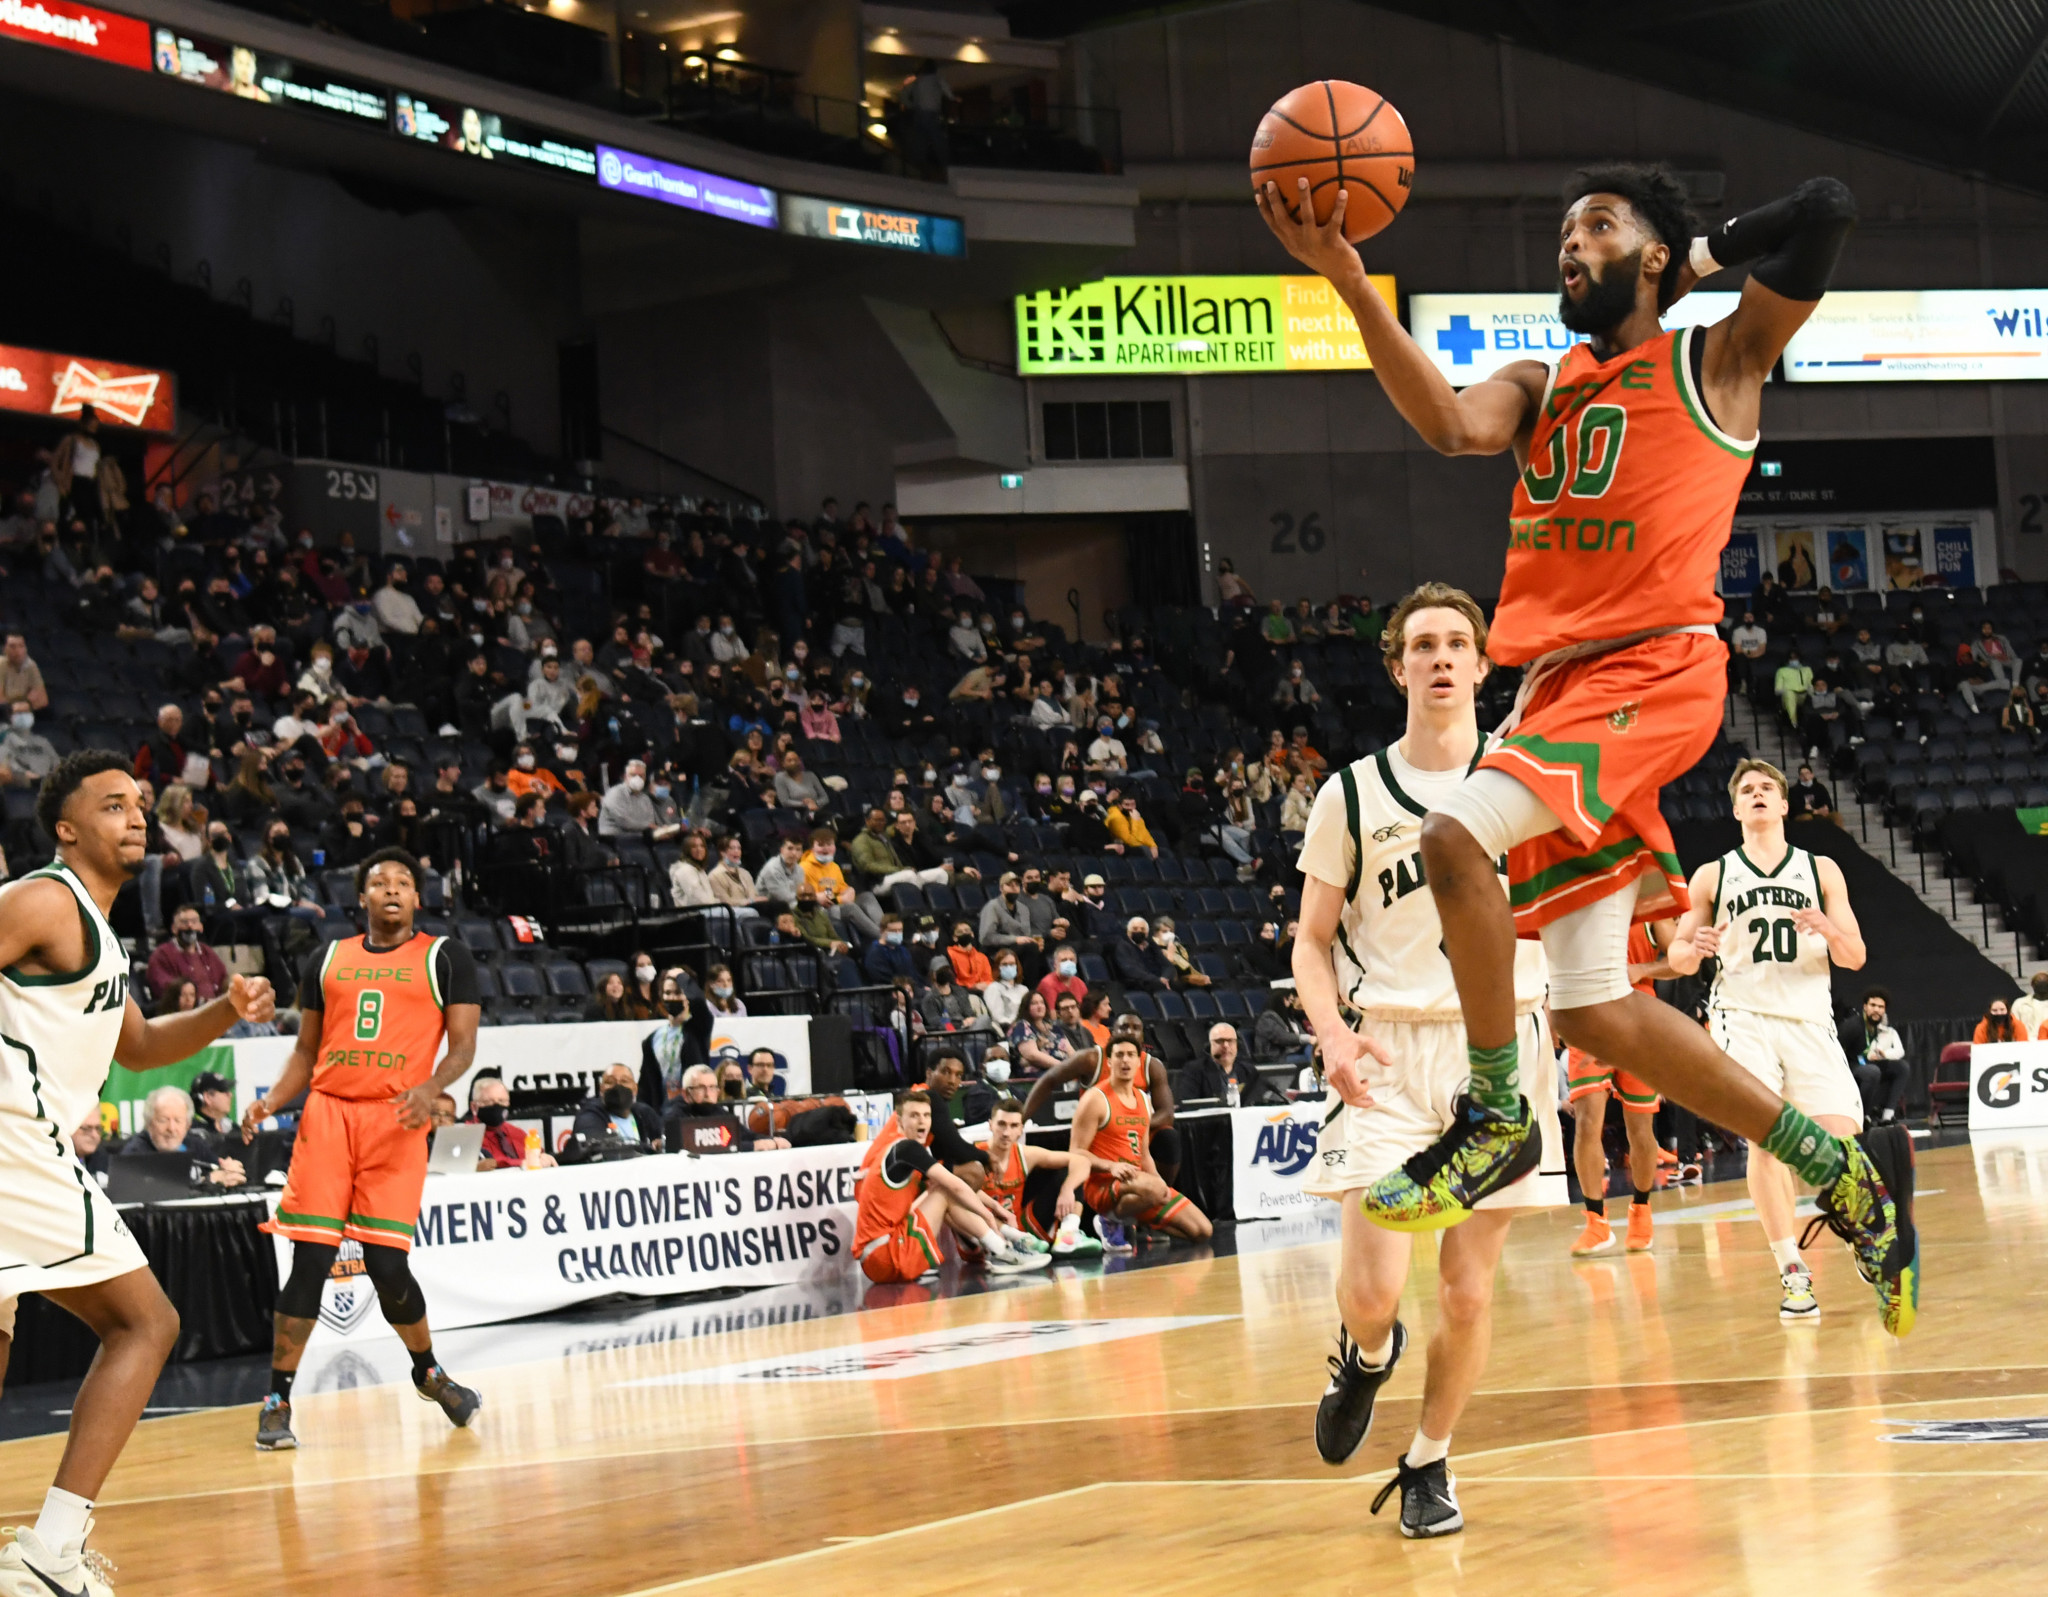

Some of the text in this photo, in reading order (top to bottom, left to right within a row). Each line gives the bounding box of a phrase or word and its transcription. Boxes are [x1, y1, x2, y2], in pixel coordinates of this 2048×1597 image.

[1346, 136, 1383, 152] AUS
[862, 211, 919, 235] TICKET
[864, 228, 921, 248] ATLANTIC
[1286, 284, 1330, 305] Find
[1113, 285, 1274, 336] Killam
[1492, 314, 1563, 324] MEDAV
[1868, 312, 1904, 324] Service
[1288, 311, 1361, 333] next ho
[1988, 308, 2048, 338] Wil
[1116, 341, 1276, 365] APARTMENT REIT
[1289, 338, 1367, 361] with us.
[326, 470, 358, 498] 25
[1789, 490, 1817, 500] DUKE
[1270, 512, 1325, 553] 26
[1722, 547, 1757, 559] CHILL
[1936, 541, 1970, 552] CHILL
[1937, 551, 1962, 562] POP
[1723, 558, 1748, 568] POP
[1723, 567, 1747, 579] FUN
[1938, 560, 1962, 573] FUN
[1378, 851, 1427, 909] PA
[1748, 917, 1798, 963] 20
[336, 967, 414, 982] CAPE
[354, 988, 384, 1042] 8
[326, 1049, 407, 1071] BRETON
[1977, 1061, 2020, 1108] G
[1115, 1115, 1149, 1127] CAPE
[694, 1126, 723, 1148] POSS
[1260, 1190, 1302, 1208] Powered
[414, 1196, 528, 1248] MEN'S
[542, 1194, 568, 1236] &
[579, 1177, 742, 1232] WOMEN'S
[557, 1217, 841, 1285] CHAMPIONSHIPS
